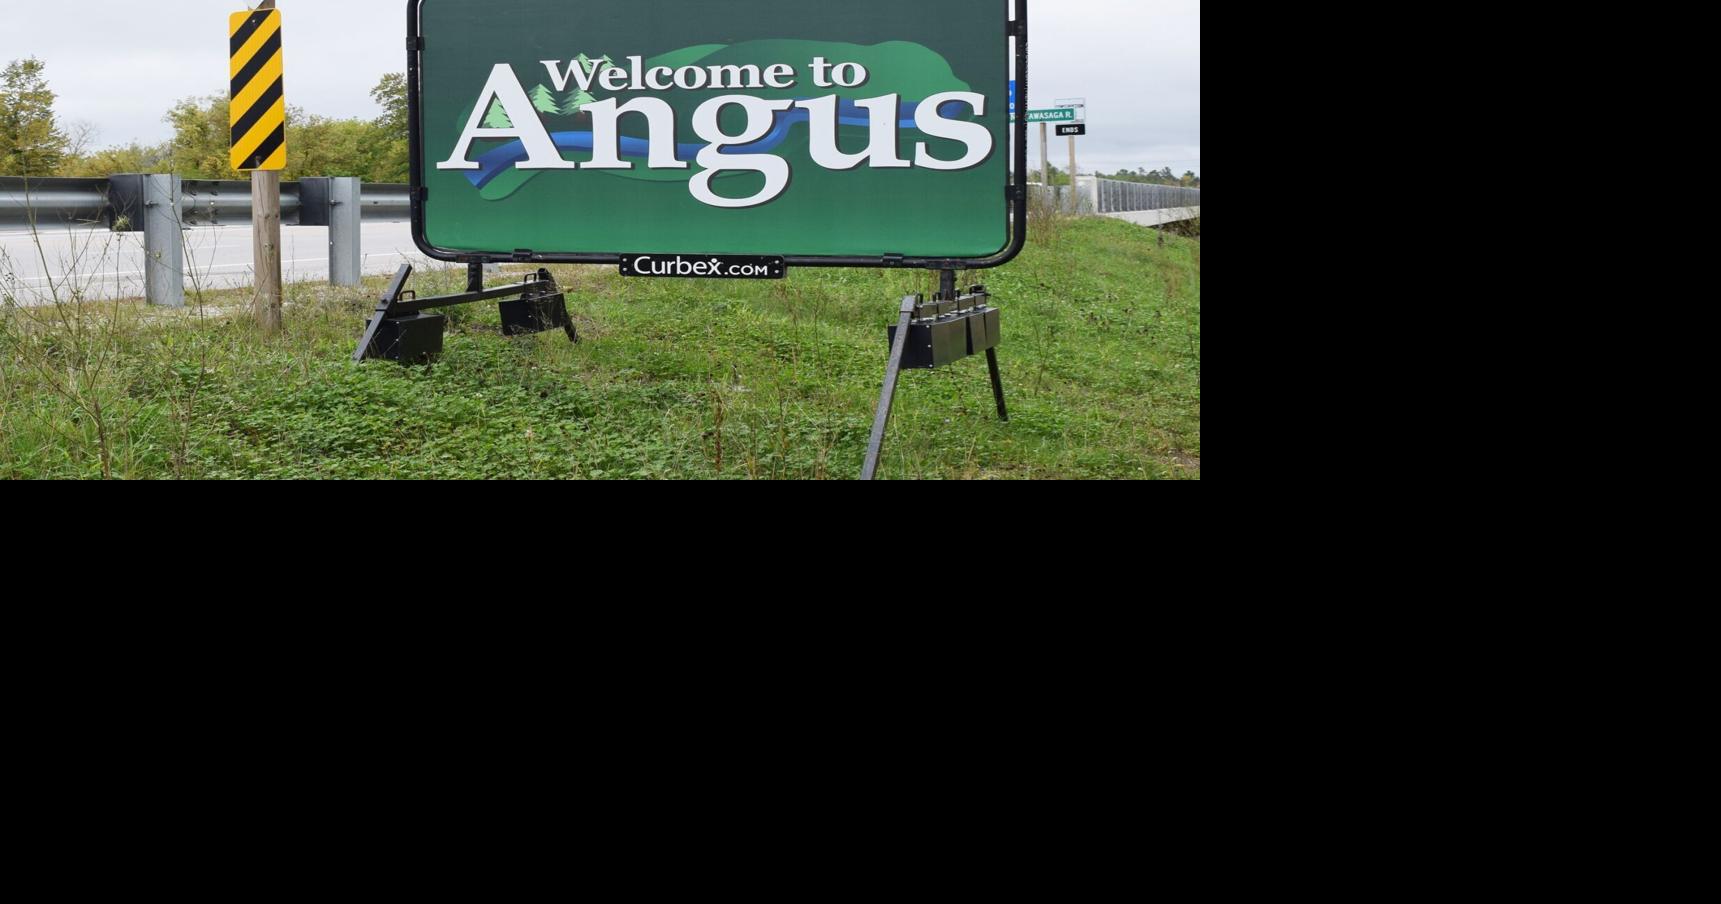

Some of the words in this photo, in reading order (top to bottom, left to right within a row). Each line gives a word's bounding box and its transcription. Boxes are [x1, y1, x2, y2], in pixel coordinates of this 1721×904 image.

[541, 55, 796, 91] Welcome
[809, 55, 868, 87] to
[437, 62, 994, 208] Angus
